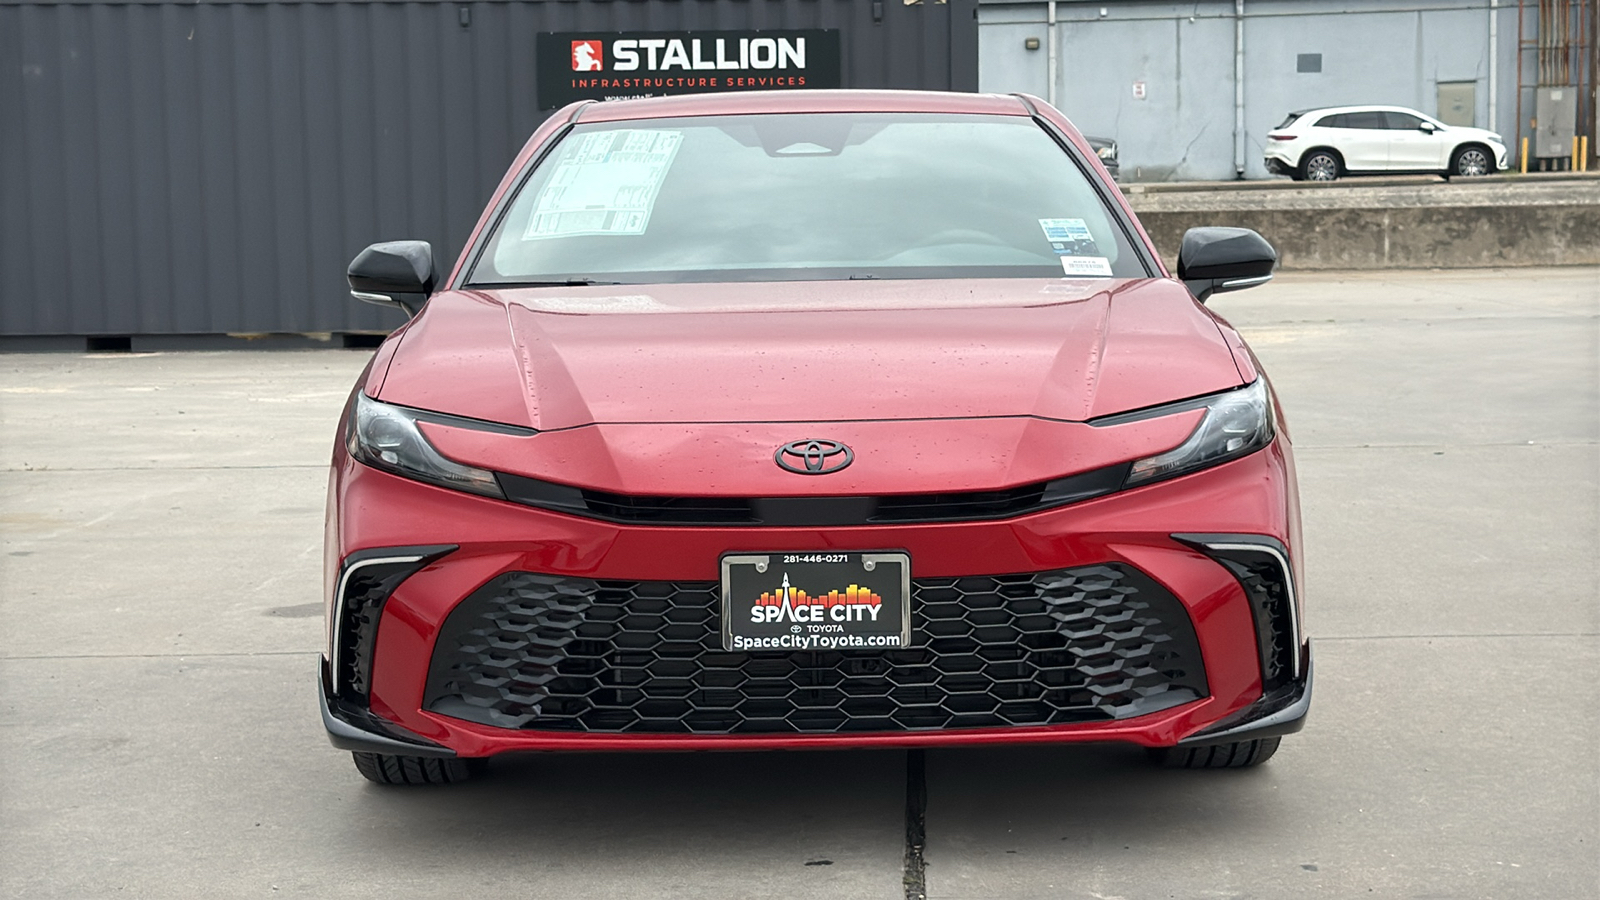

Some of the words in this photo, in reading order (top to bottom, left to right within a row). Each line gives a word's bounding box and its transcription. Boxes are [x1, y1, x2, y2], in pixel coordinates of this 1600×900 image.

[612, 37, 806, 71] STALLION
[572, 77, 718, 88] INFRASTRUCTURE
[726, 76, 806, 86] SERVICES
[783, 554, 848, 563] 281-446-0271
[830, 604, 883, 622] CITY
[806, 624, 845, 633] TOYOTA
[733, 634, 901, 650] SpaceCityToyota.com
